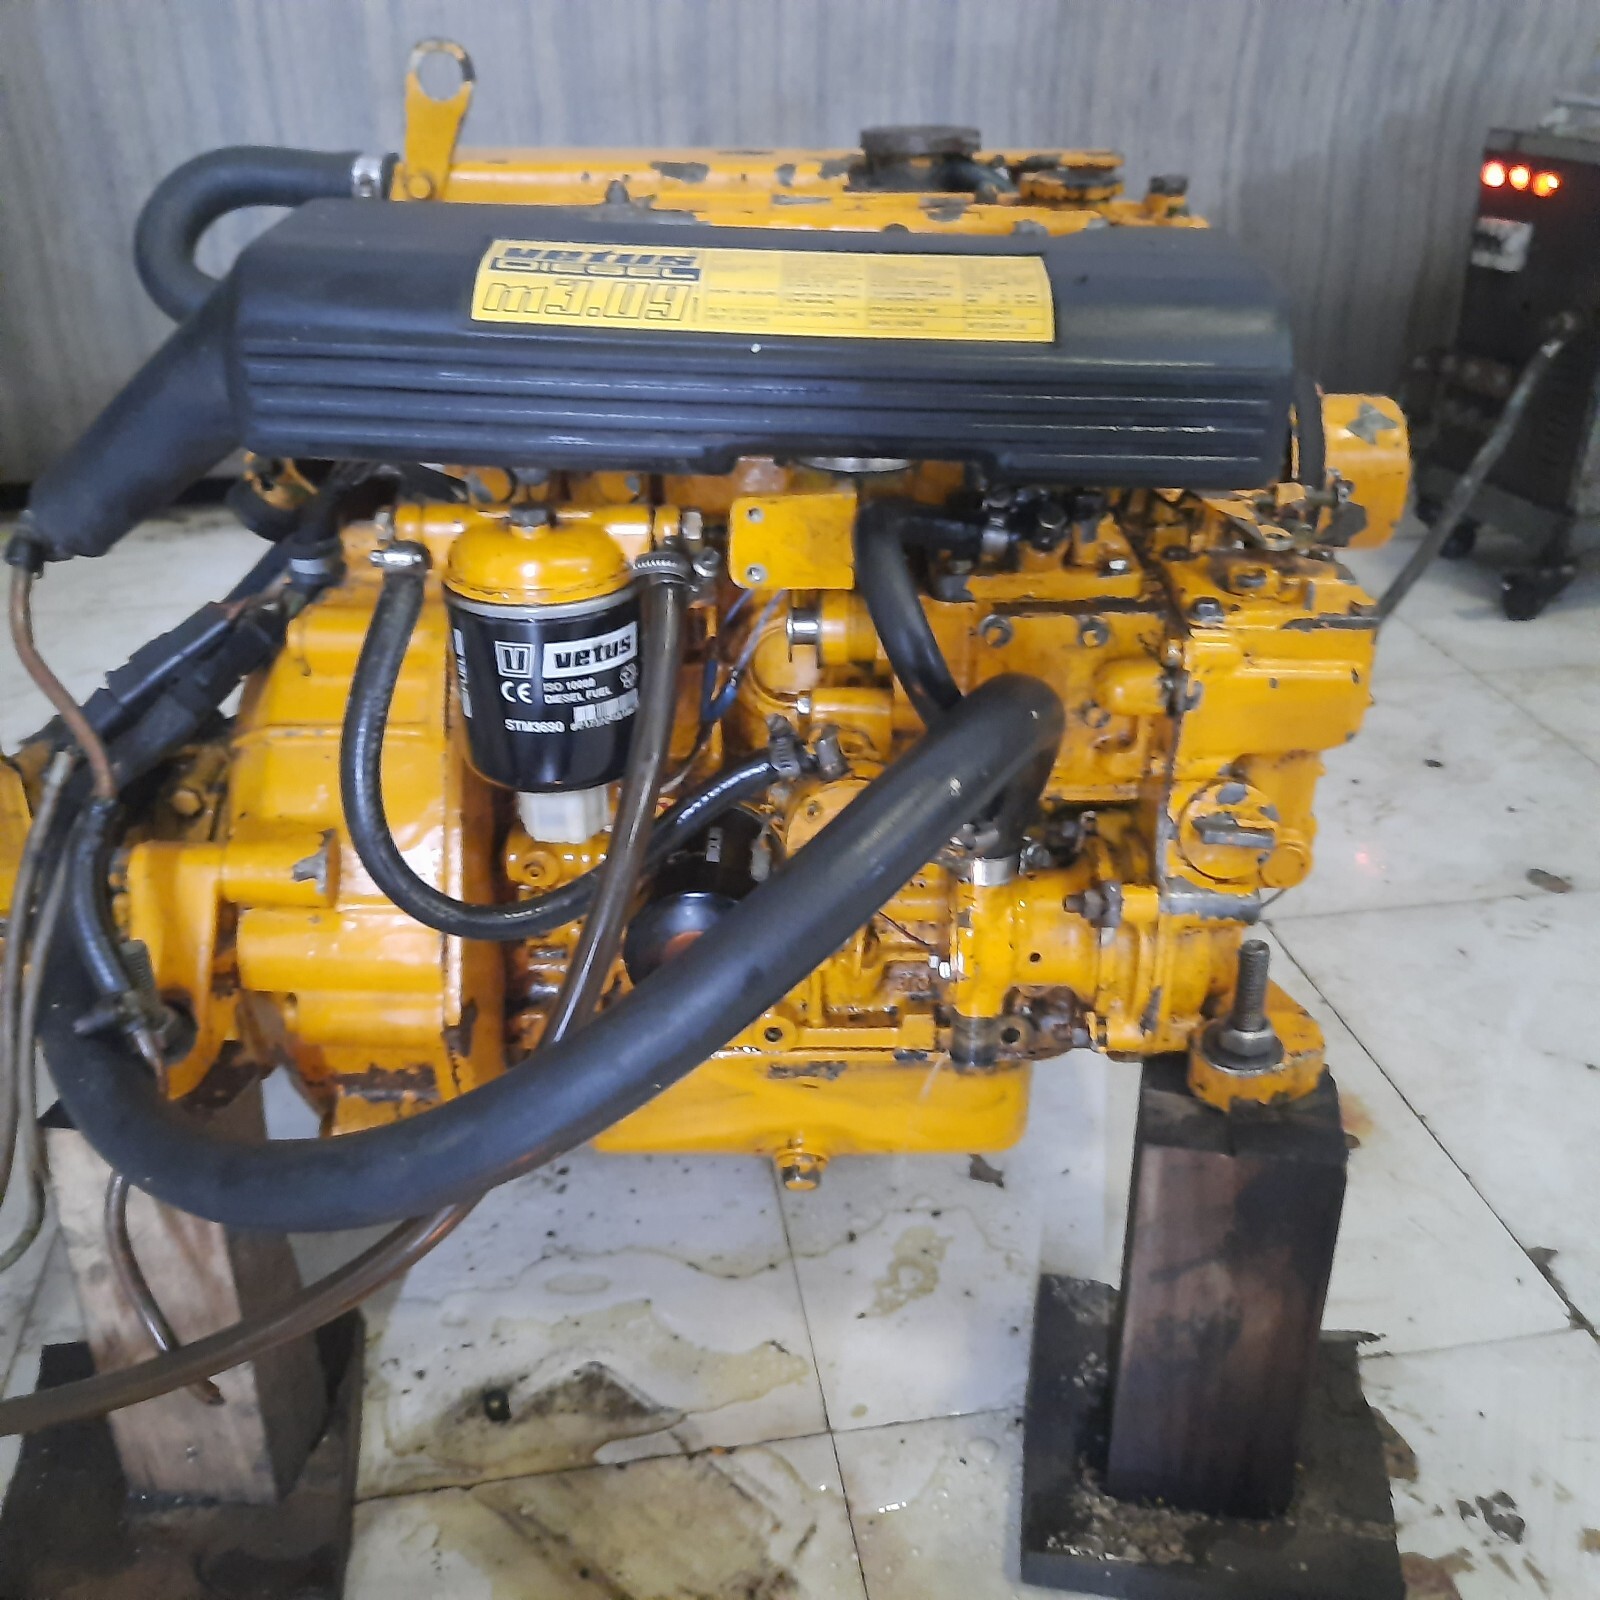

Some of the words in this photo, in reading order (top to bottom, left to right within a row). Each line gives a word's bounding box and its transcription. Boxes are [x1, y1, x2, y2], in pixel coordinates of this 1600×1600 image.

[482, 279, 692, 321] m3.09
[554, 635, 631, 669] vetus
[500, 681, 533, 704] CE
[543, 692, 586, 705] DIESEL
[586, 685, 613, 700] FUEL
